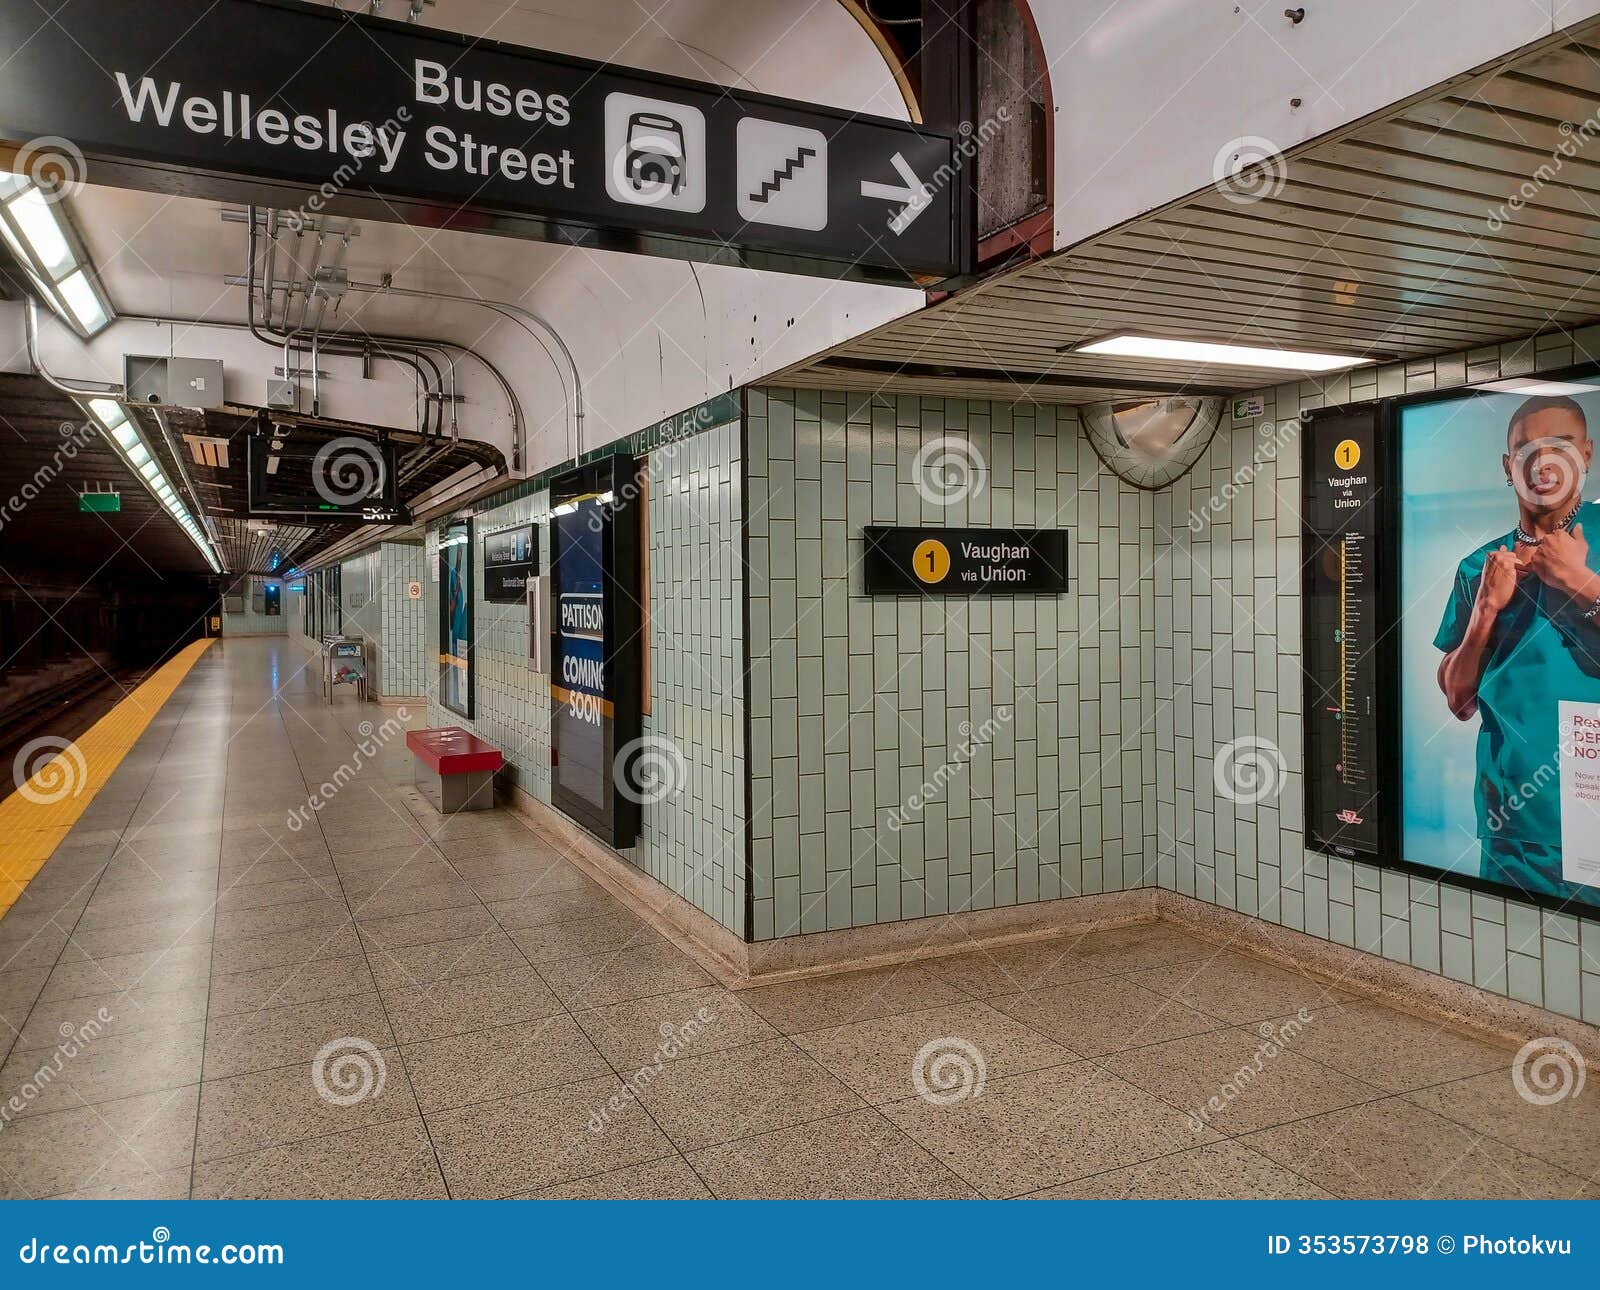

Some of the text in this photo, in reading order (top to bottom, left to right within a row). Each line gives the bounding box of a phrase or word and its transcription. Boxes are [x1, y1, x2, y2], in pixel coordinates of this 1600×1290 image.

[414, 58, 571, 127] Buses
[115, 71, 576, 190] Wellesley Street
[630, 407, 699, 455] WELLESLEY
[1343, 447, 1350, 462] 1
[1328, 476, 1367, 488] Vaughan
[1334, 498, 1361, 509] Union
[1342, 489, 1353, 497] via
[925, 550, 935, 573] 1
[961, 542, 1030, 562] Vaughan
[961, 565, 1026, 582] via Union
[562, 603, 604, 631] PATTISON
[569, 690, 601, 727] SOON
